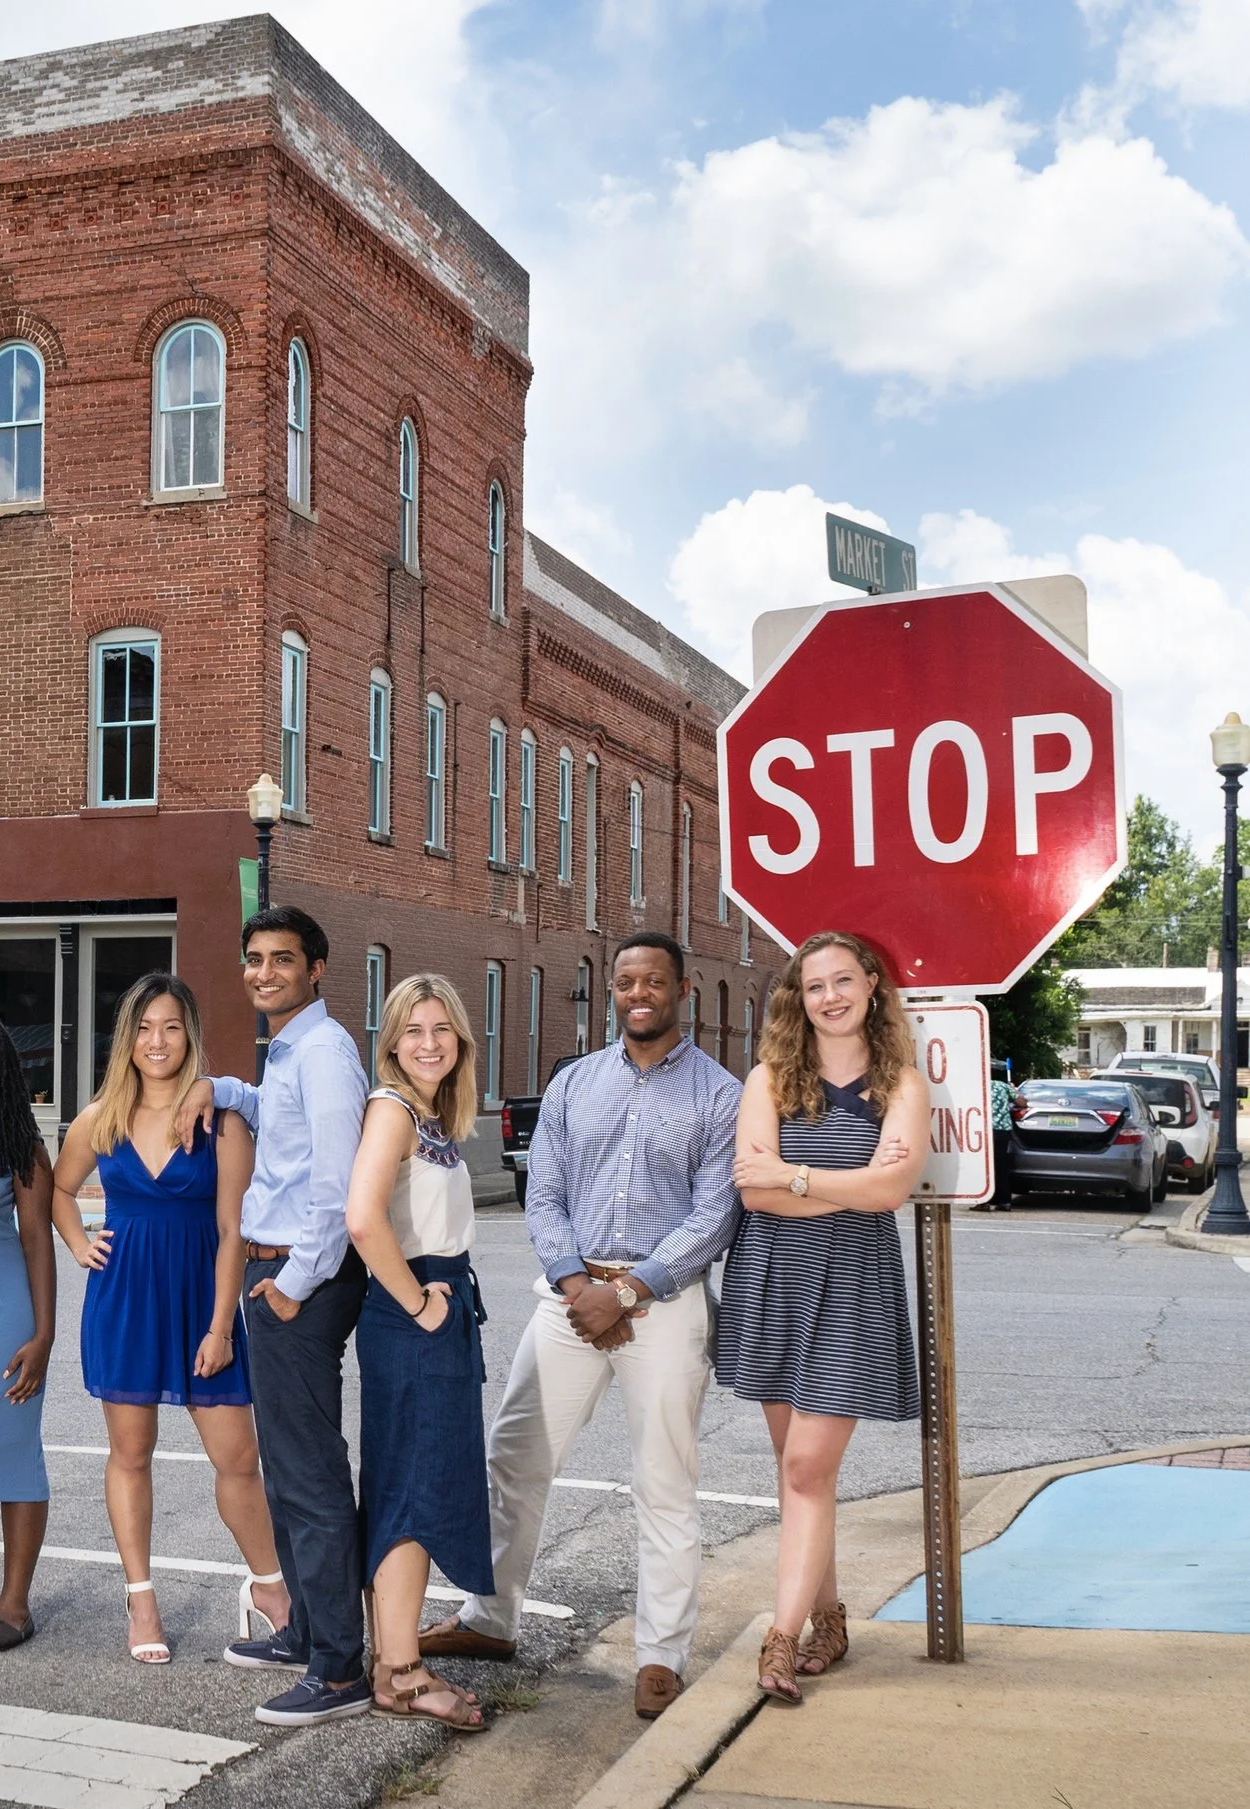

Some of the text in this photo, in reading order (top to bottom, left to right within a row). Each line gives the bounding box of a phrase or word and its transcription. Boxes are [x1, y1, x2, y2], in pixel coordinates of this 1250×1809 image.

[835, 525, 915, 592] MARKET ST
[748, 712, 1093, 875] STOP
